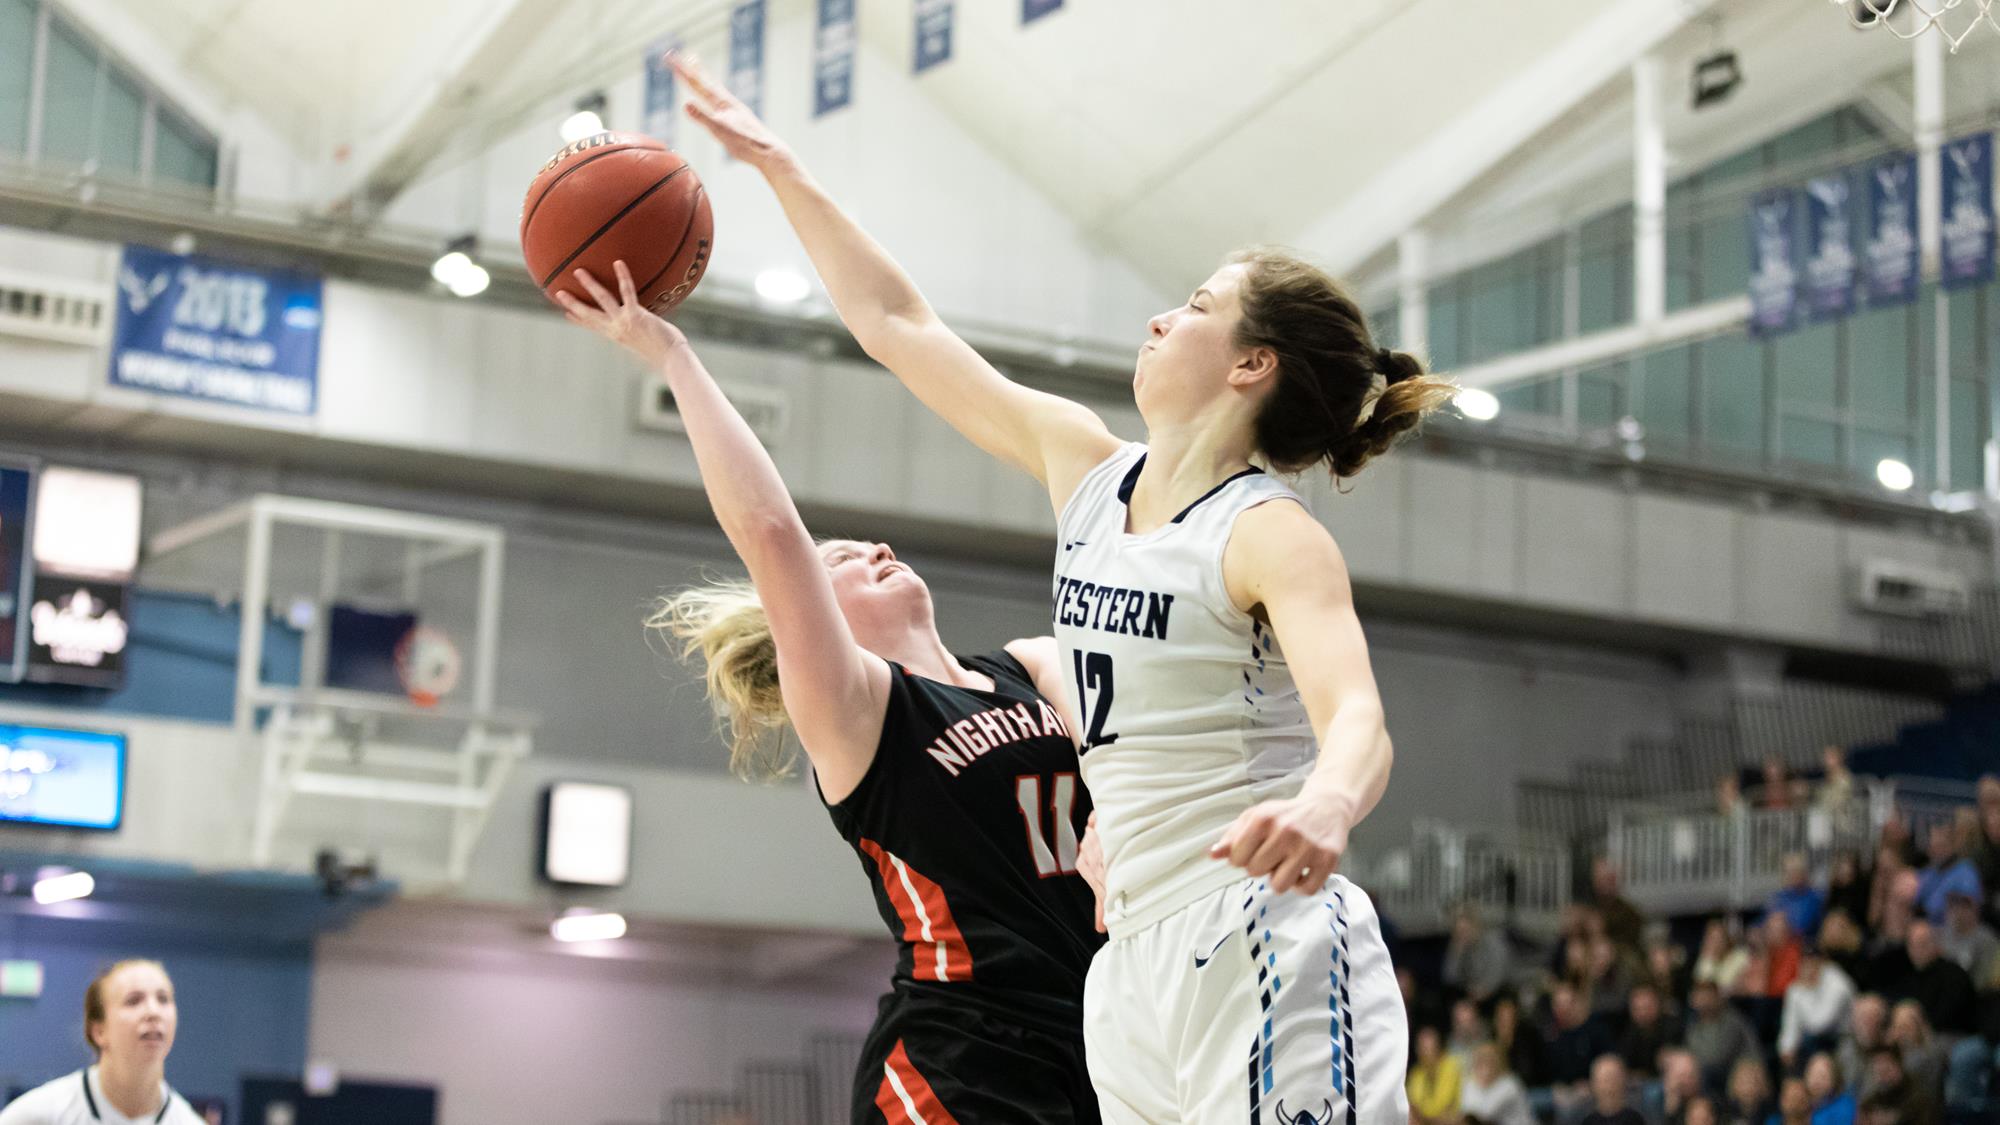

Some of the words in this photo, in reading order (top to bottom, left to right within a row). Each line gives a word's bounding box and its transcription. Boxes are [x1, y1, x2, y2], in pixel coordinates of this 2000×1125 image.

[925, 699, 1071, 778] NIGHTHA
[1072, 648, 1119, 757] 12
[1015, 771, 1081, 879] 11
